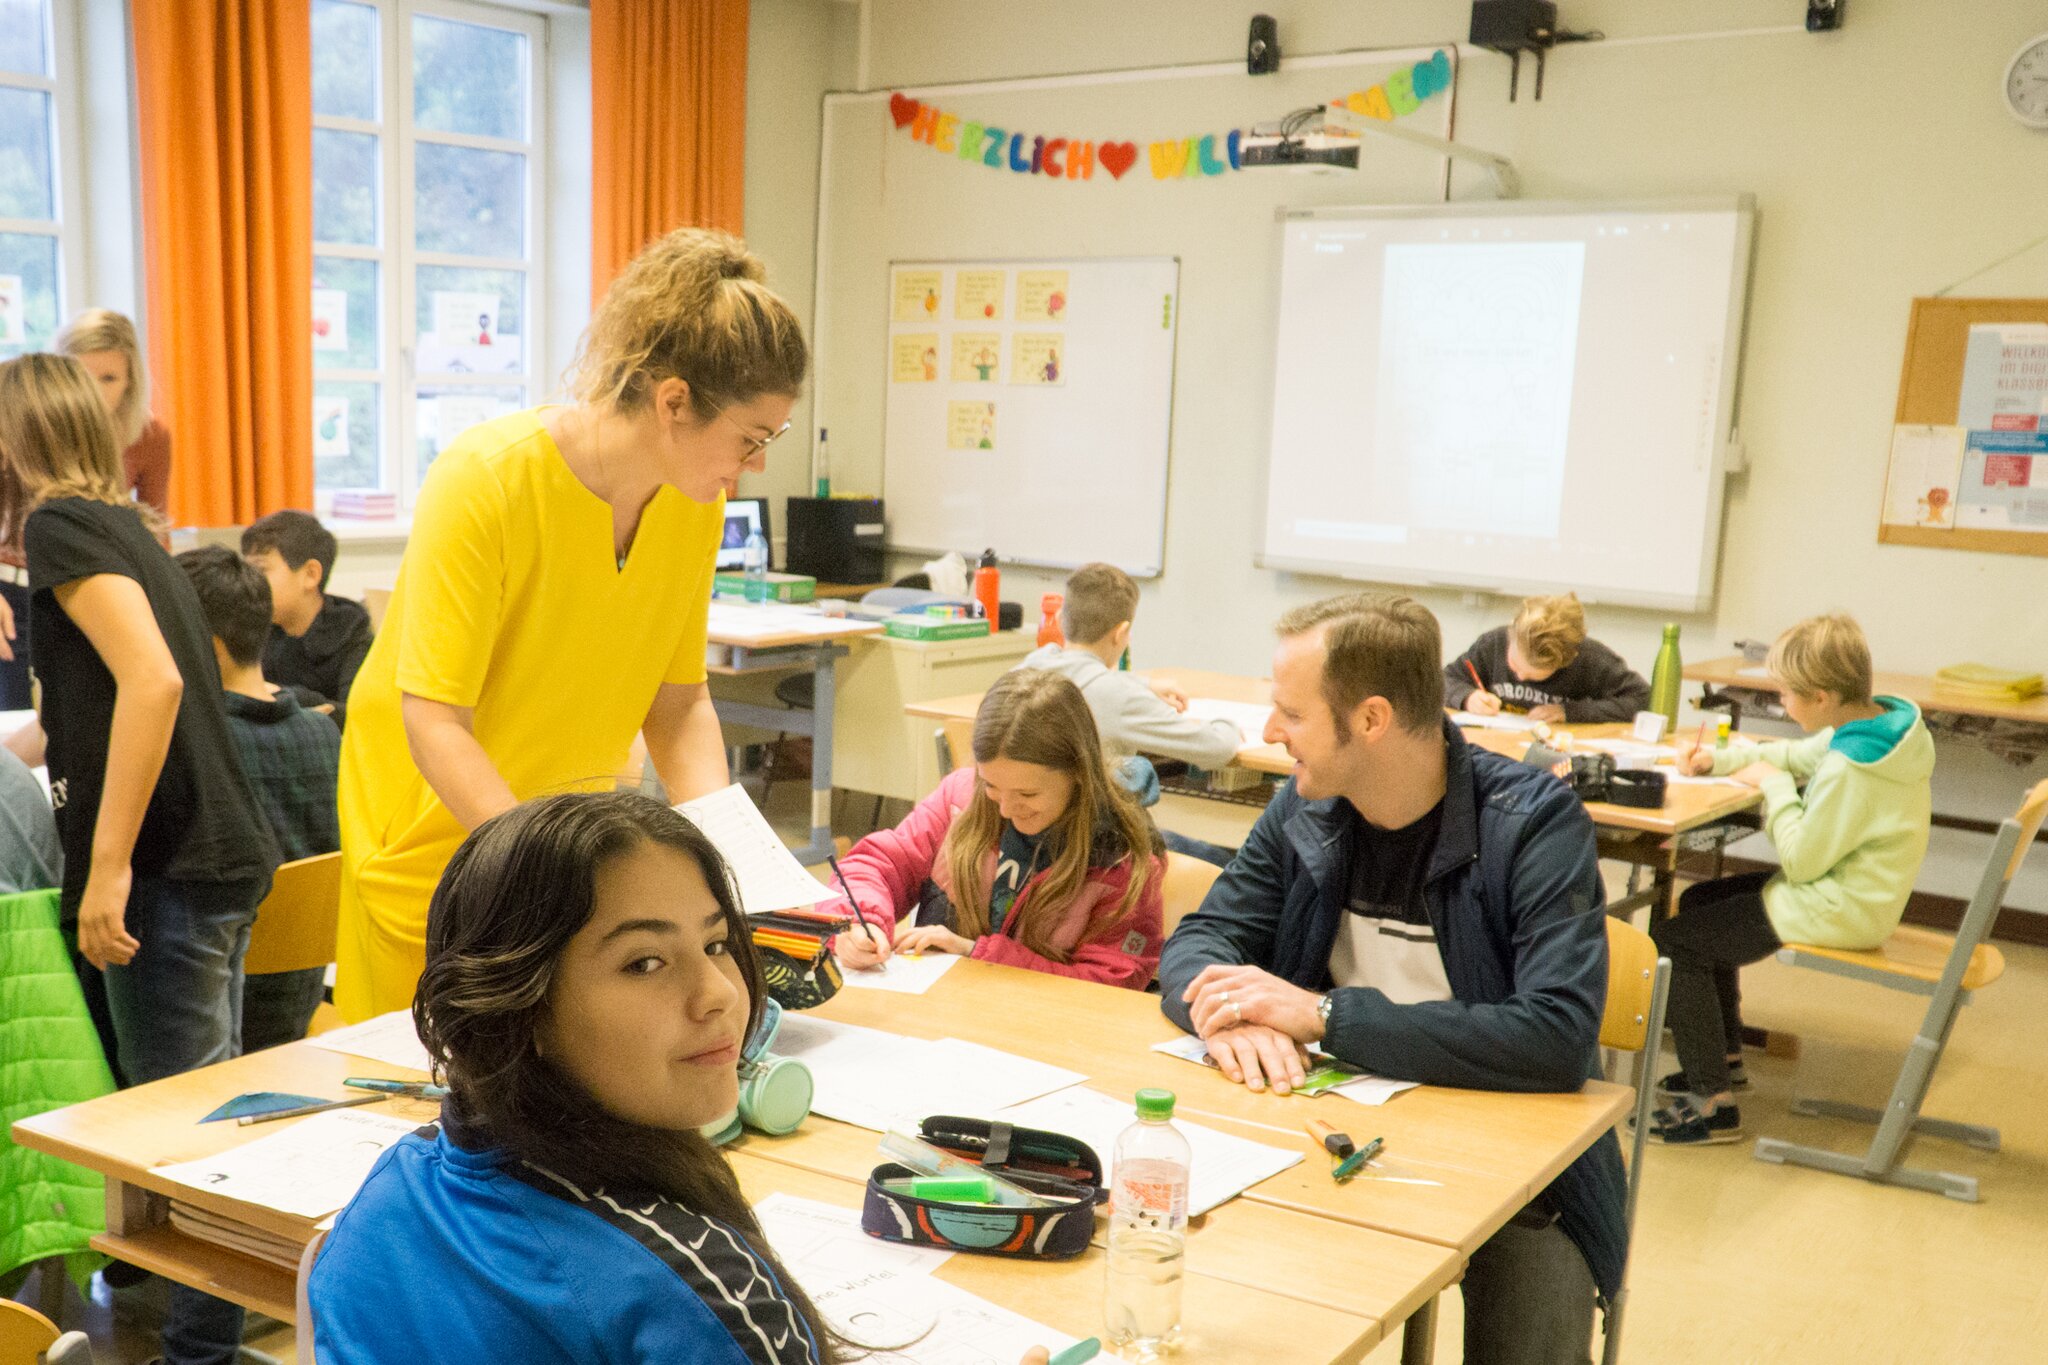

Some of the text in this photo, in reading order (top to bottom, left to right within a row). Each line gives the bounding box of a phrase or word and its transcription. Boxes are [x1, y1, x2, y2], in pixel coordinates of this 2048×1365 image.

[911, 104, 1094, 181] HERZLICH
[2001, 345, 2048, 359] WILLKO
[1493, 682, 1570, 705] BROOKLY
